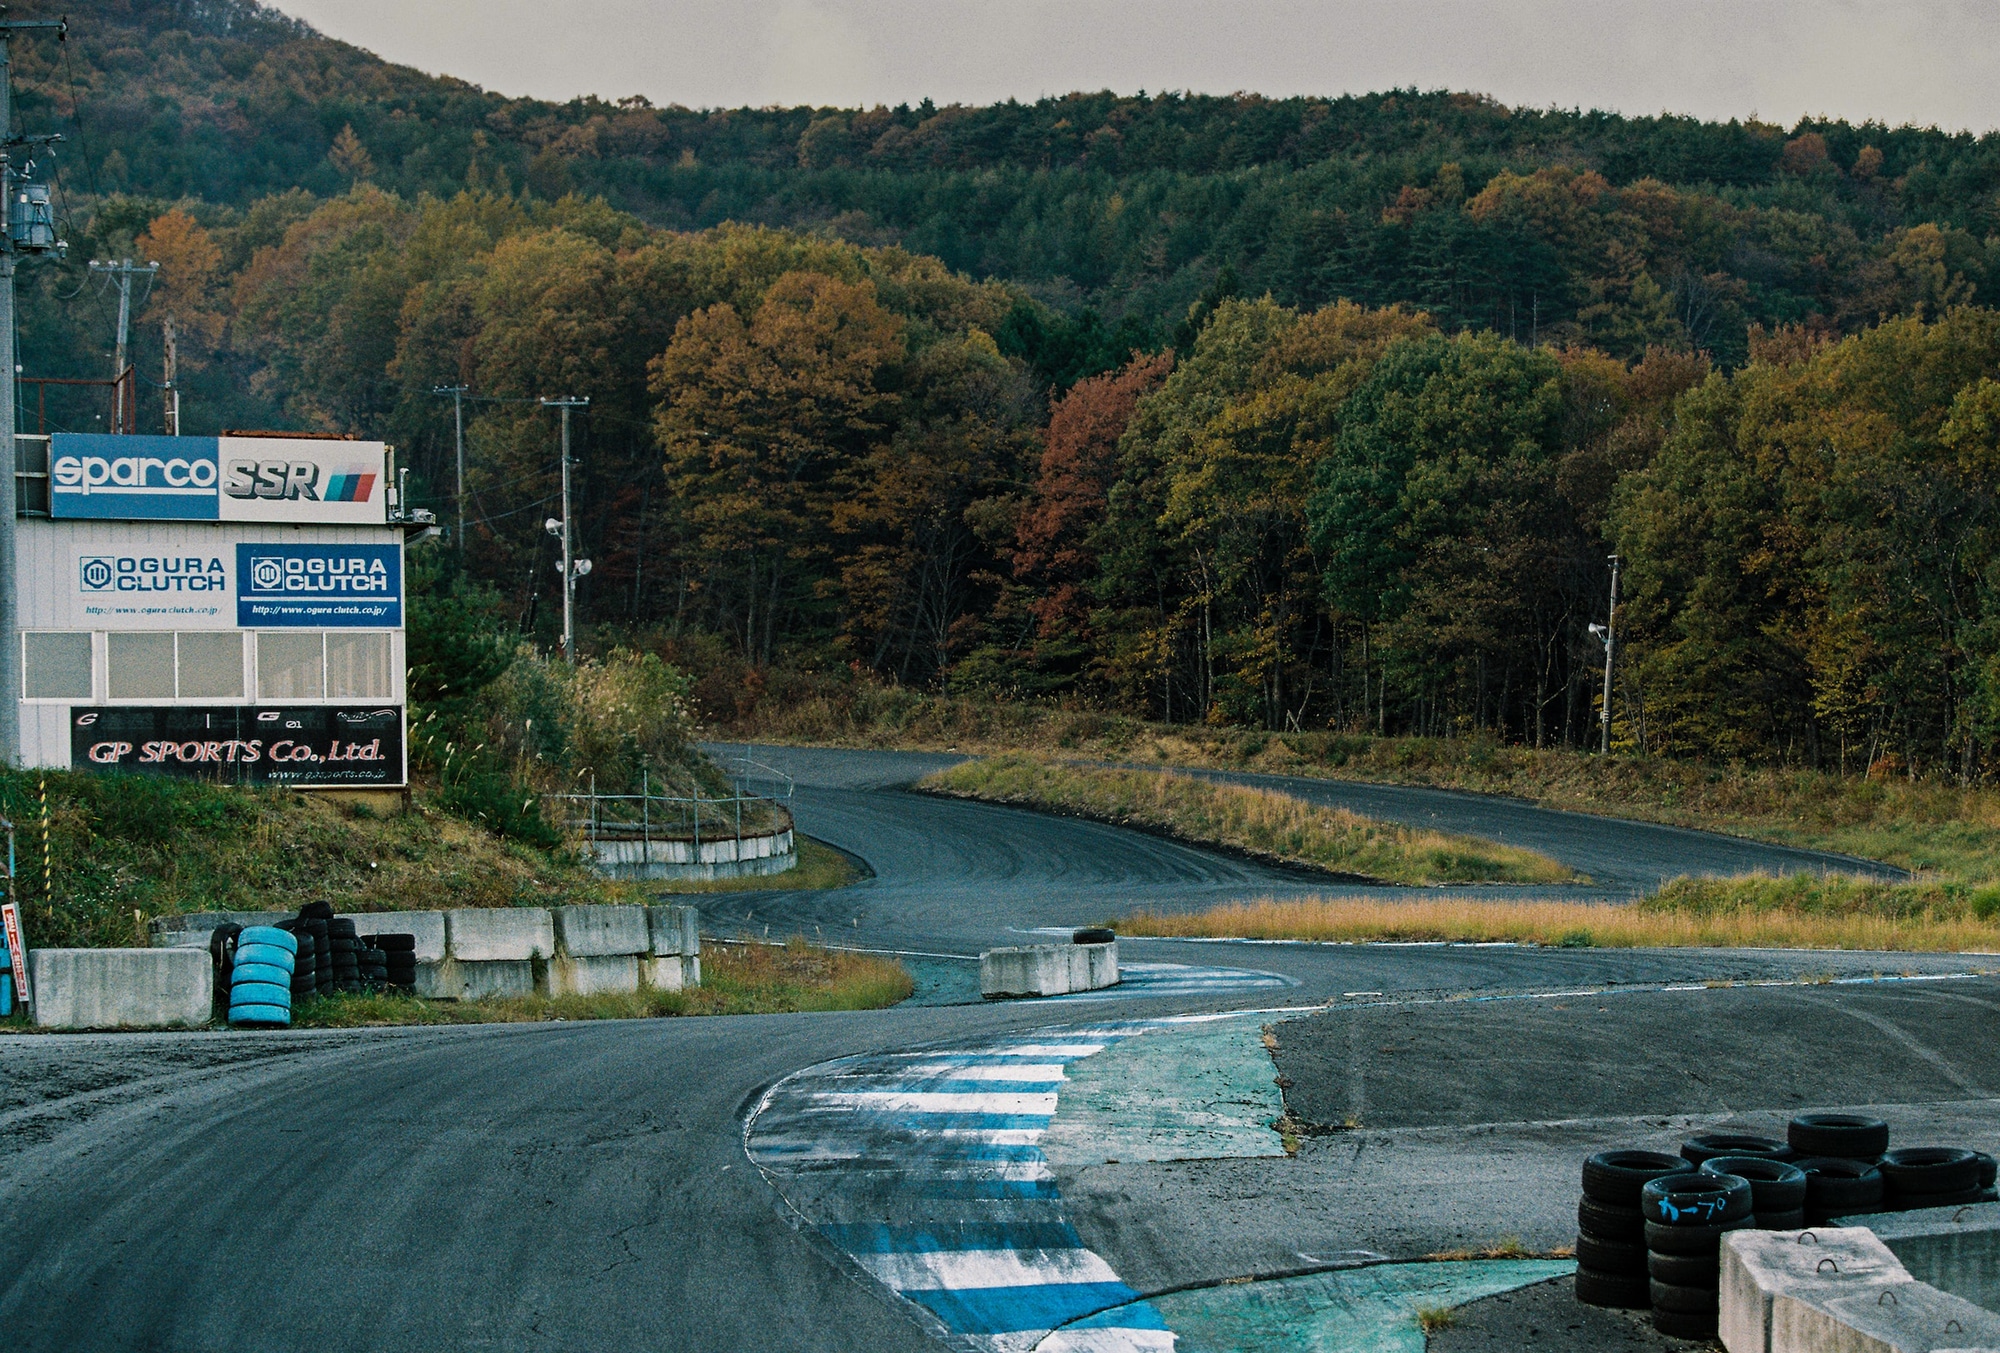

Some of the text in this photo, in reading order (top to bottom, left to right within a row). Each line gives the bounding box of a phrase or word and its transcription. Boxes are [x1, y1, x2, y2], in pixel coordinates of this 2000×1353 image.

[54, 456, 217, 495] sparco
[223, 459, 321, 501] SSR
[117, 557, 225, 573] OGURA
[285, 558, 387, 574] OGURA
[117, 575, 225, 591] CLUTCH
[285, 575, 387, 591] CLUTCH
[89, 741, 133, 763] GP
[139, 739, 263, 763] SPORTS
